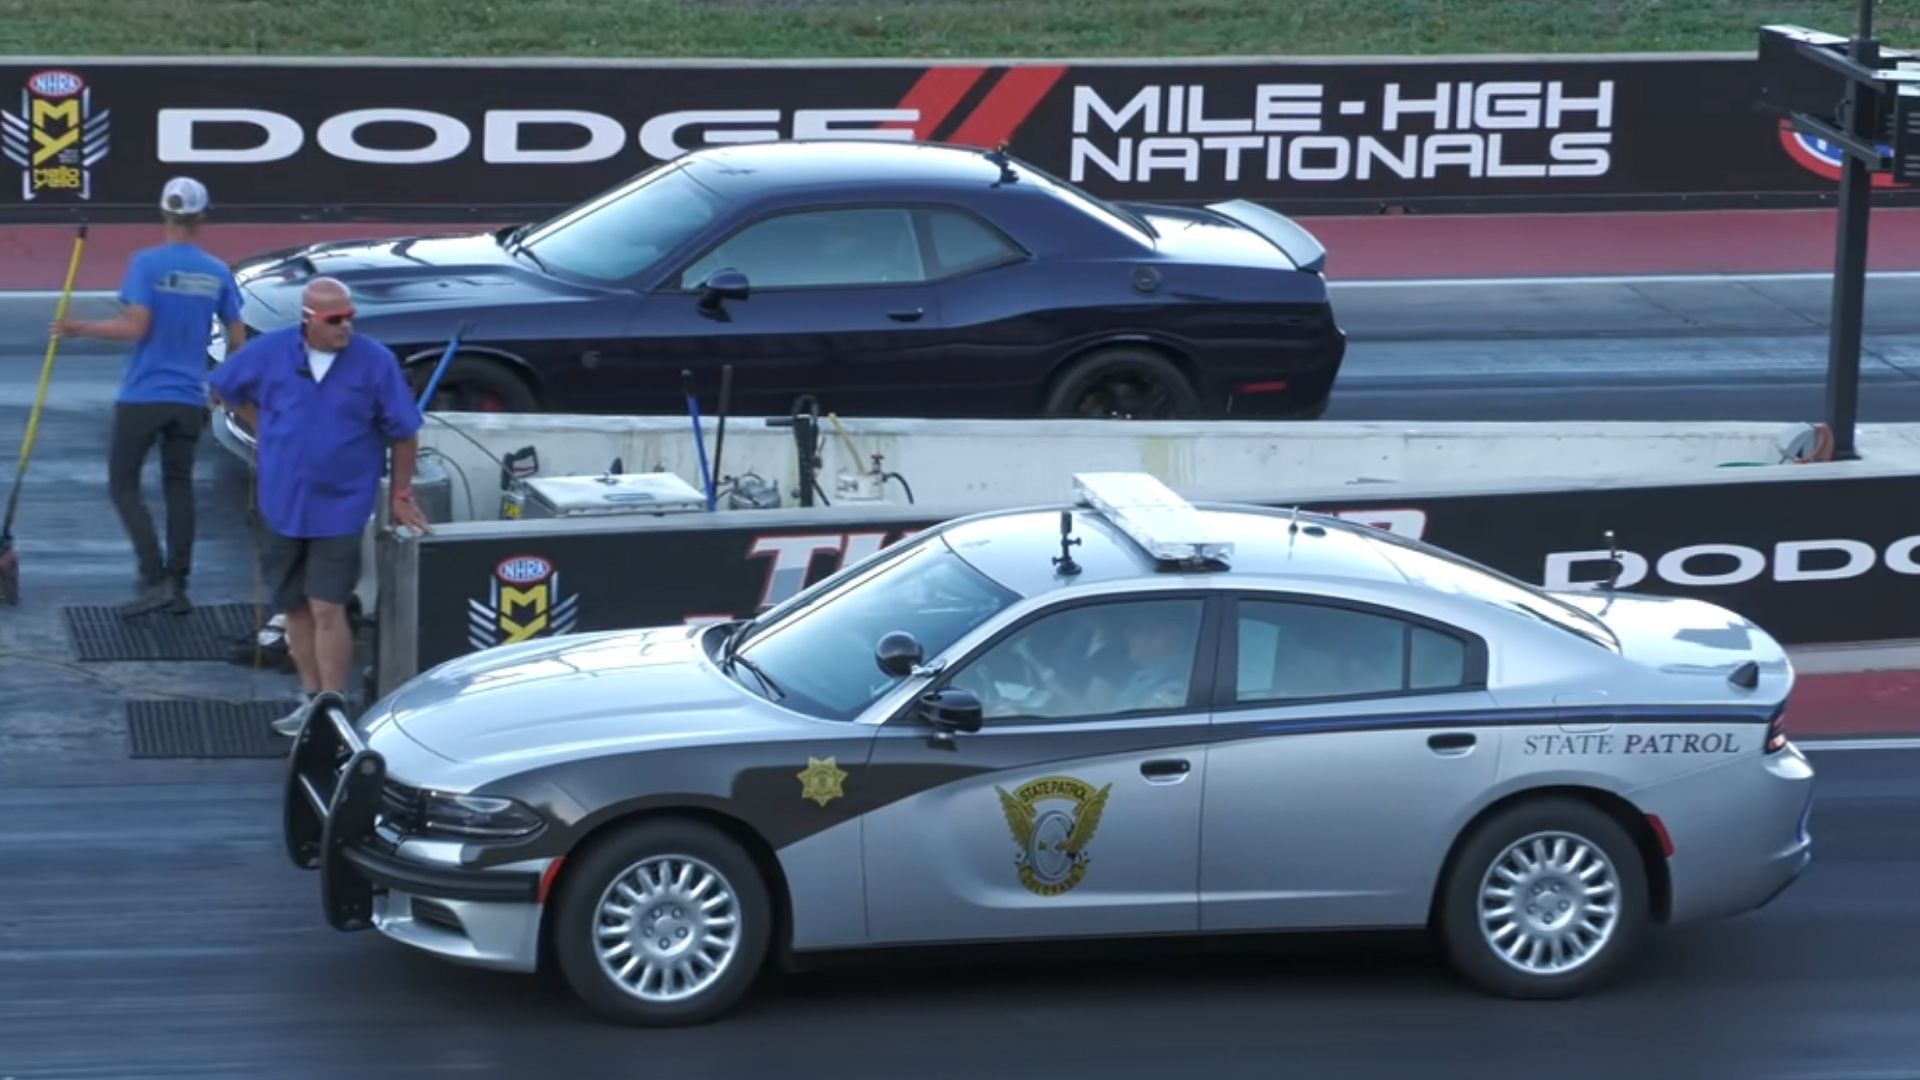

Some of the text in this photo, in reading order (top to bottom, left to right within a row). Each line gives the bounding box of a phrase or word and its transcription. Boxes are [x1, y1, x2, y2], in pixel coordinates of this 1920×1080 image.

[36, 75, 80, 93] NHRA
[157, 107, 920, 164] DODGE
[1070, 133, 1613, 183] NATIONALS
[502, 559, 547, 580] NHRA
[1524, 732, 1741, 756] STATE PATROL
[1020, 780, 1089, 803] STATE PATROL
